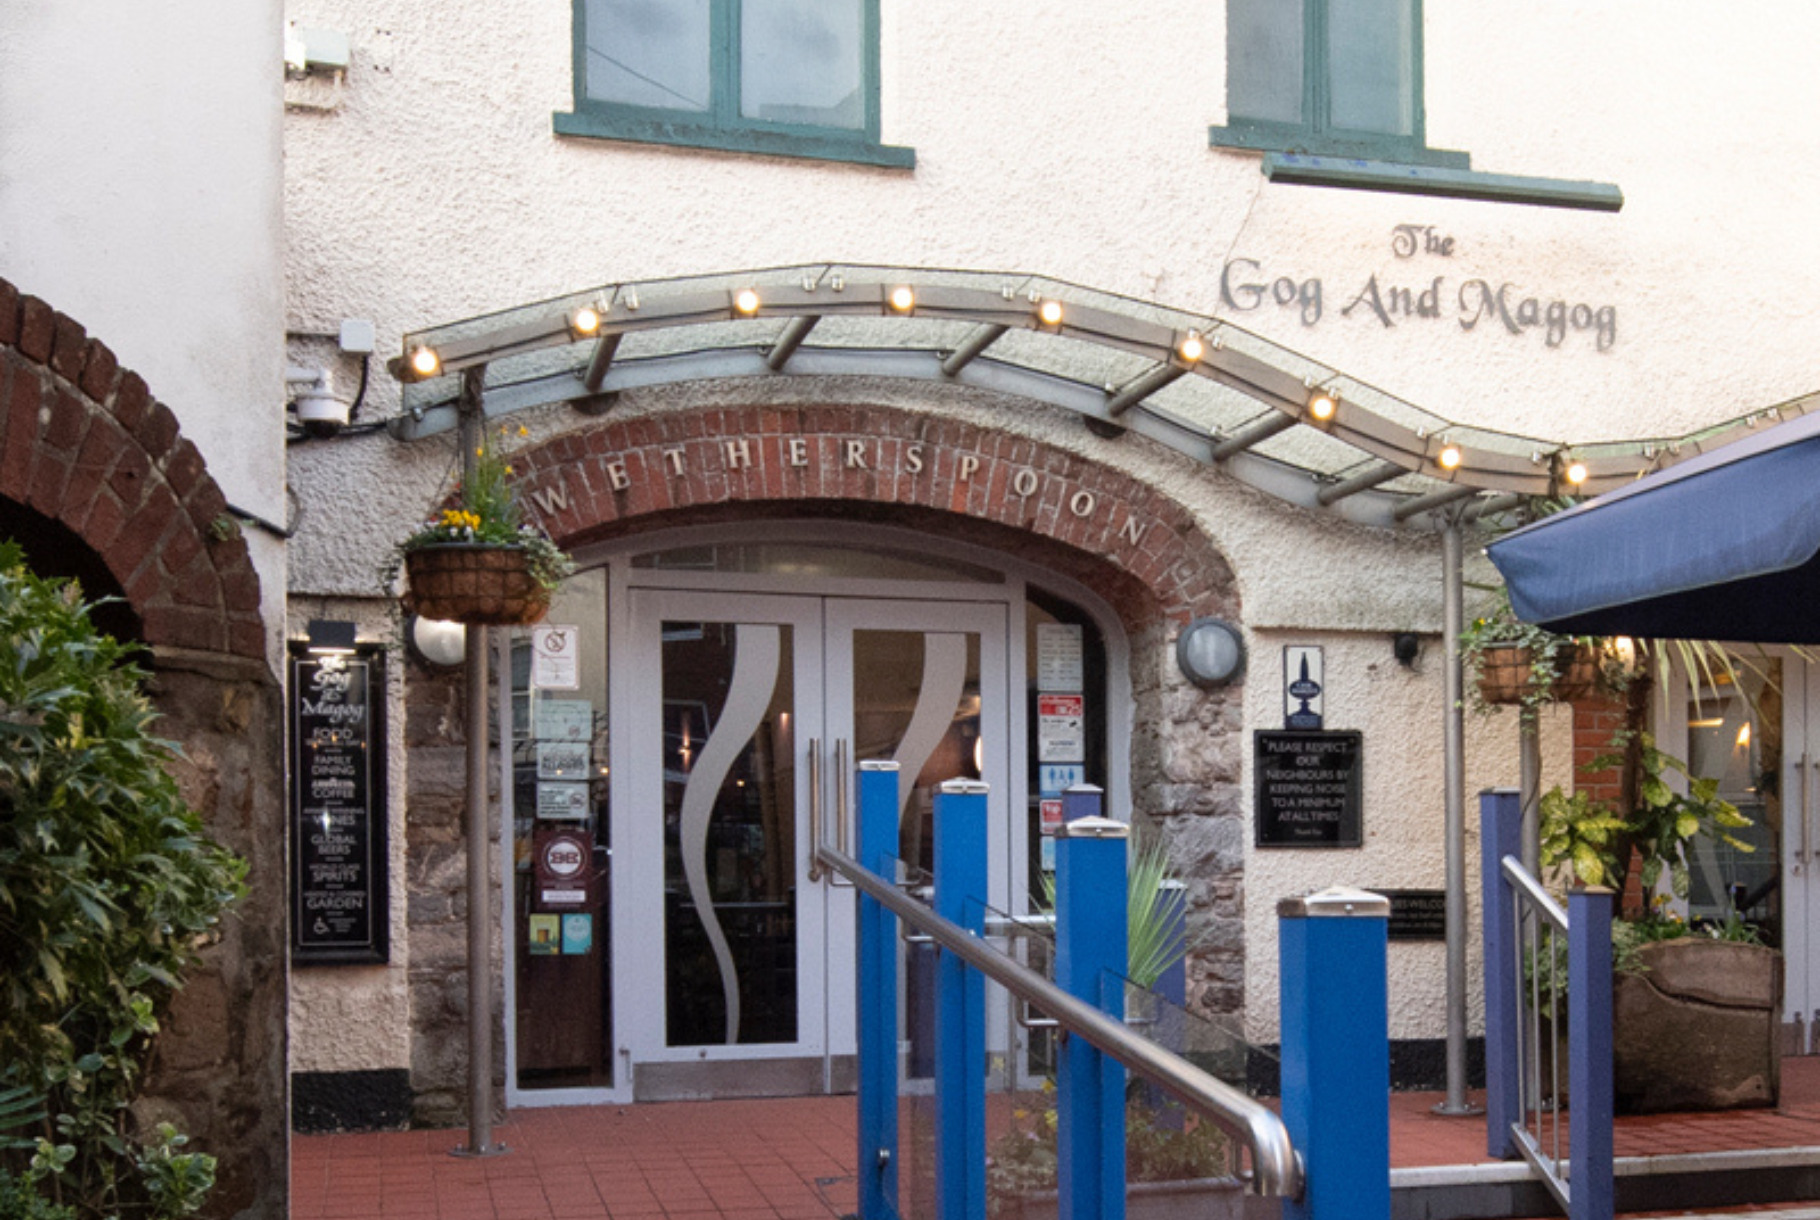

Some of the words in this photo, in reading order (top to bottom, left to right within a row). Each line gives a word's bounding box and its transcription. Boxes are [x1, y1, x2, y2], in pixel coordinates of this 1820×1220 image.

[1392, 222, 1456, 258] The
[1219, 256, 1323, 327] Gog
[1341, 273, 1445, 329] And
[1458, 275, 1617, 352] Magog
[531, 438, 1147, 547] WETHERSPOON
[302, 697, 364, 723] Magog
[313, 727, 353, 739] FOOD
[1267, 741, 1302, 752] PLEASE
[1305, 742, 1348, 753] RESPECT
[1295, 755, 1320, 766] OUR
[1266, 769, 1334, 780] NEIGHBOURS
[1269, 783, 1313, 794] KEEPING
[1315, 783, 1346, 794] NOISE
[1271, 797, 1286, 807] TO
[1297, 797, 1345, 807] MINIMUM
[1278, 811, 1292, 821] AT
[1292, 811, 1310, 821] ALL
[1310, 811, 1339, 821] TIMES
